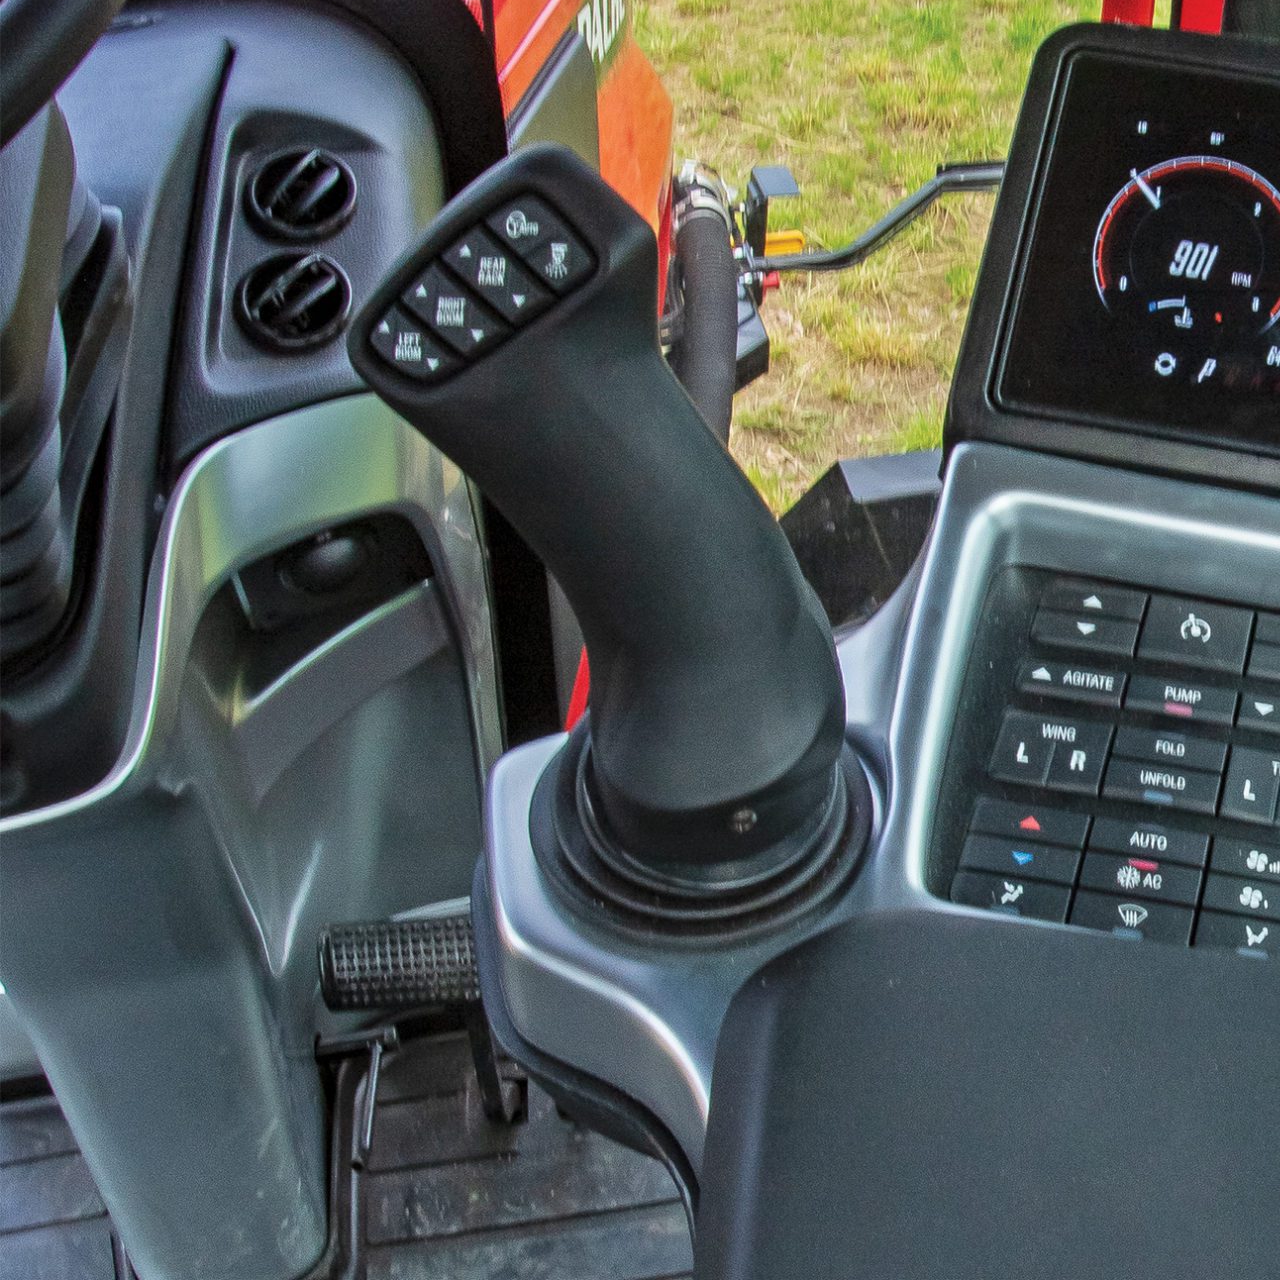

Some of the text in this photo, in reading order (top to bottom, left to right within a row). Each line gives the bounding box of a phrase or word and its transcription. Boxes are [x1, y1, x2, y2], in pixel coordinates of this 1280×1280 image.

[519, 221, 539, 237] AUTO
[480, 256, 506, 272] REAR
[1169, 239, 1220, 281] 901
[478, 270, 505, 287] RACK
[1119, 275, 1128, 292] 0
[1231, 271, 1253, 289] RPM
[438, 296, 466, 311] RIGHT
[437, 310, 464, 327] BOOM
[399, 331, 421, 346] LEFT
[395, 344, 422, 361] BOOM
[1062, 670, 1115, 692] AGITATE
[1164, 685, 1202, 705] PUMP
[1042, 722, 1077, 743] WING
[1016, 741, 1087, 772] L R
[1155, 739, 1186, 757] FOLD
[1140, 769, 1186, 791] UNFOLD
[1243, 778, 1256, 802] L
[1130, 831, 1168, 851] AUTO
